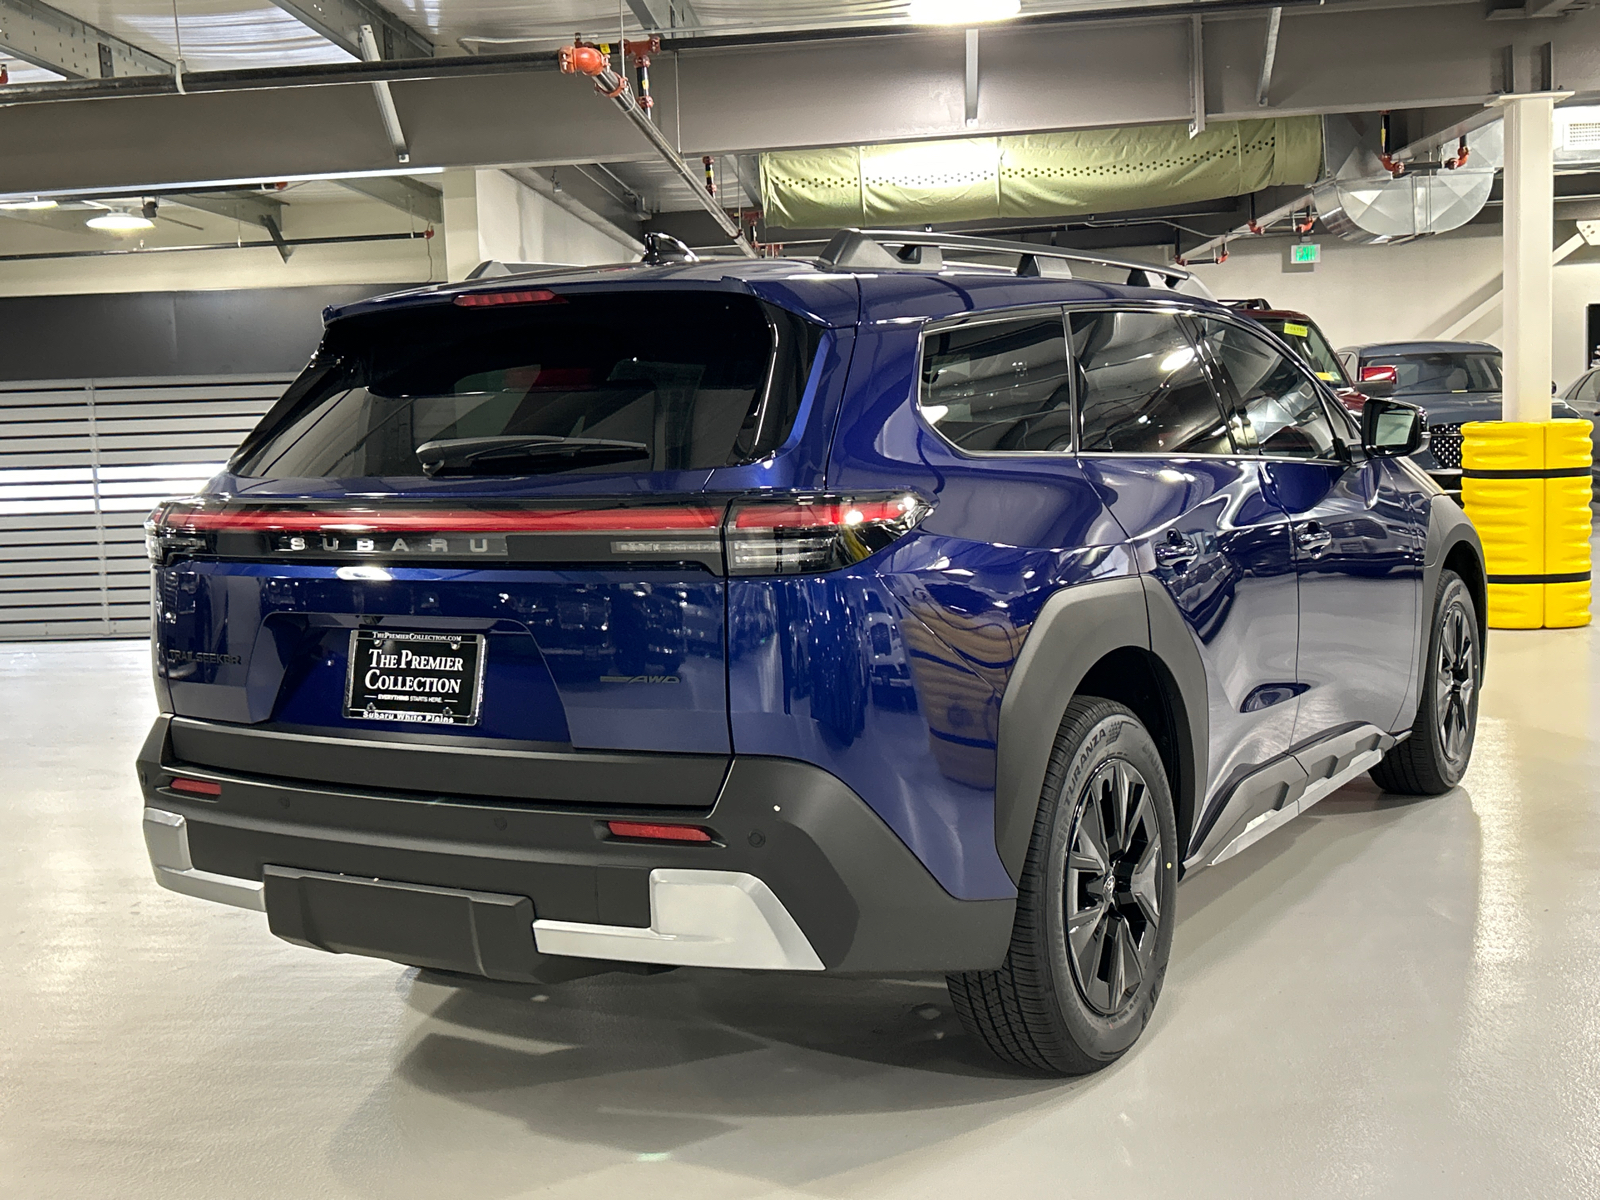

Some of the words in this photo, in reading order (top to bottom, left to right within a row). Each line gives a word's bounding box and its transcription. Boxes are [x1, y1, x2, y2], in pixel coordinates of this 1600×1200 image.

[290, 537, 488, 553] SUBARU
[368, 649, 398, 669] THE
[399, 650, 464, 672] PREMIER
[364, 669, 462, 694] COLLECTION
[629, 675, 681, 684] AWD
[362, 710, 395, 721] Subaru
[396, 712, 423, 722] White
[425, 714, 454, 724] Plains
[1064, 728, 1107, 807] TURANZA
